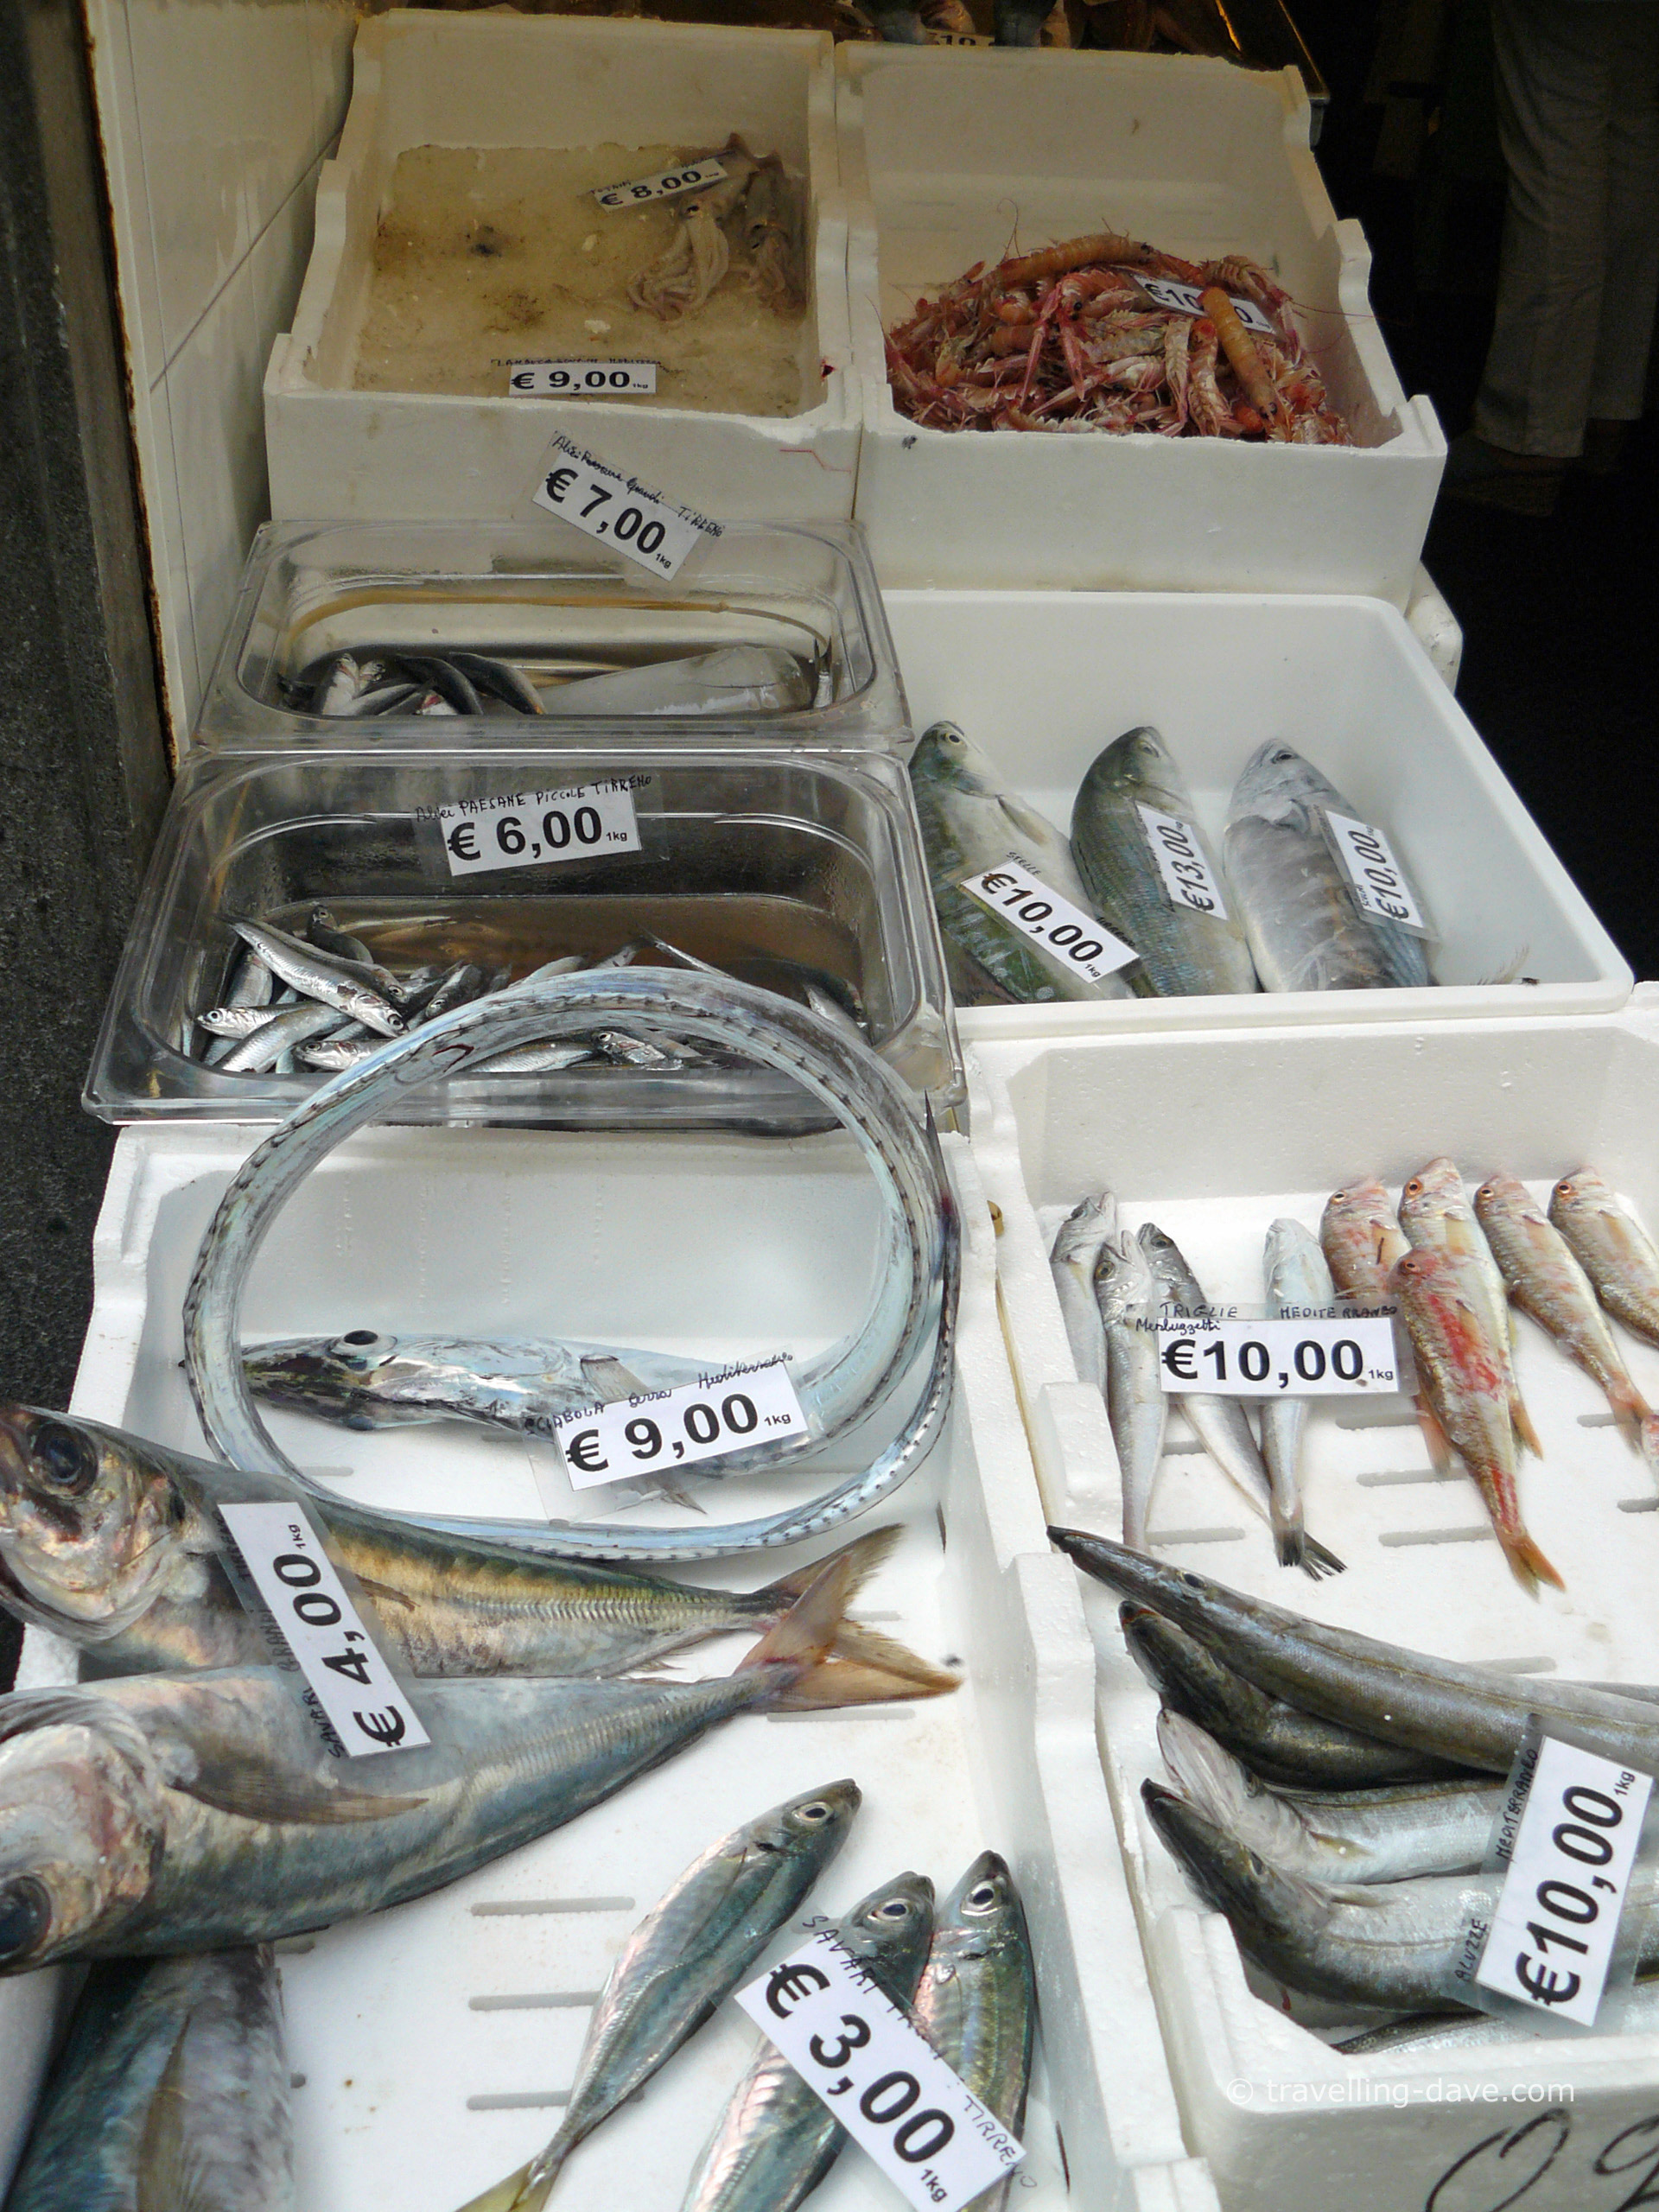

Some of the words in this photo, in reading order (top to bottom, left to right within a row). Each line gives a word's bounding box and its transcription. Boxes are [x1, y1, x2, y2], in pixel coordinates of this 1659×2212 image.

[600, 193, 624, 206] €
[631, 170, 702, 199] 8,00
[511, 372, 535, 390] €
[549, 371, 630, 391] 9,00
[545, 467, 579, 504] €
[580, 484, 666, 554] 7,00
[656, 553, 672, 570] 1kg
[447, 822, 481, 861] €
[496, 806, 602, 859] 6,00
[606, 831, 627, 842] 1kg
[1156, 825, 1215, 912] €13,00
[1348, 830, 1409, 919] €10,00
[981, 873, 1104, 963] €10,00
[1084, 963, 1102, 978] 1kg
[1160, 1301, 1238, 1319] TRIGLIE
[1161, 1338, 1363, 1389] €10,00
[1368, 1369, 1393, 1381] 1kg
[565, 1429, 610, 1471] €
[625, 1393, 759, 1459] 9,00
[764, 1413, 791, 1427] 1kg
[288, 1524, 307, 1549] 1kg
[272, 1554, 372, 1685] 4,00
[353, 1705, 406, 1748] €
[1515, 1785, 1624, 2006] €10,00
[1613, 1770, 1636, 1797] 1kg
[766, 1963, 831, 2019] €
[809, 2013, 956, 2164] 3,00
[919, 2168, 949, 2203] 1kg
